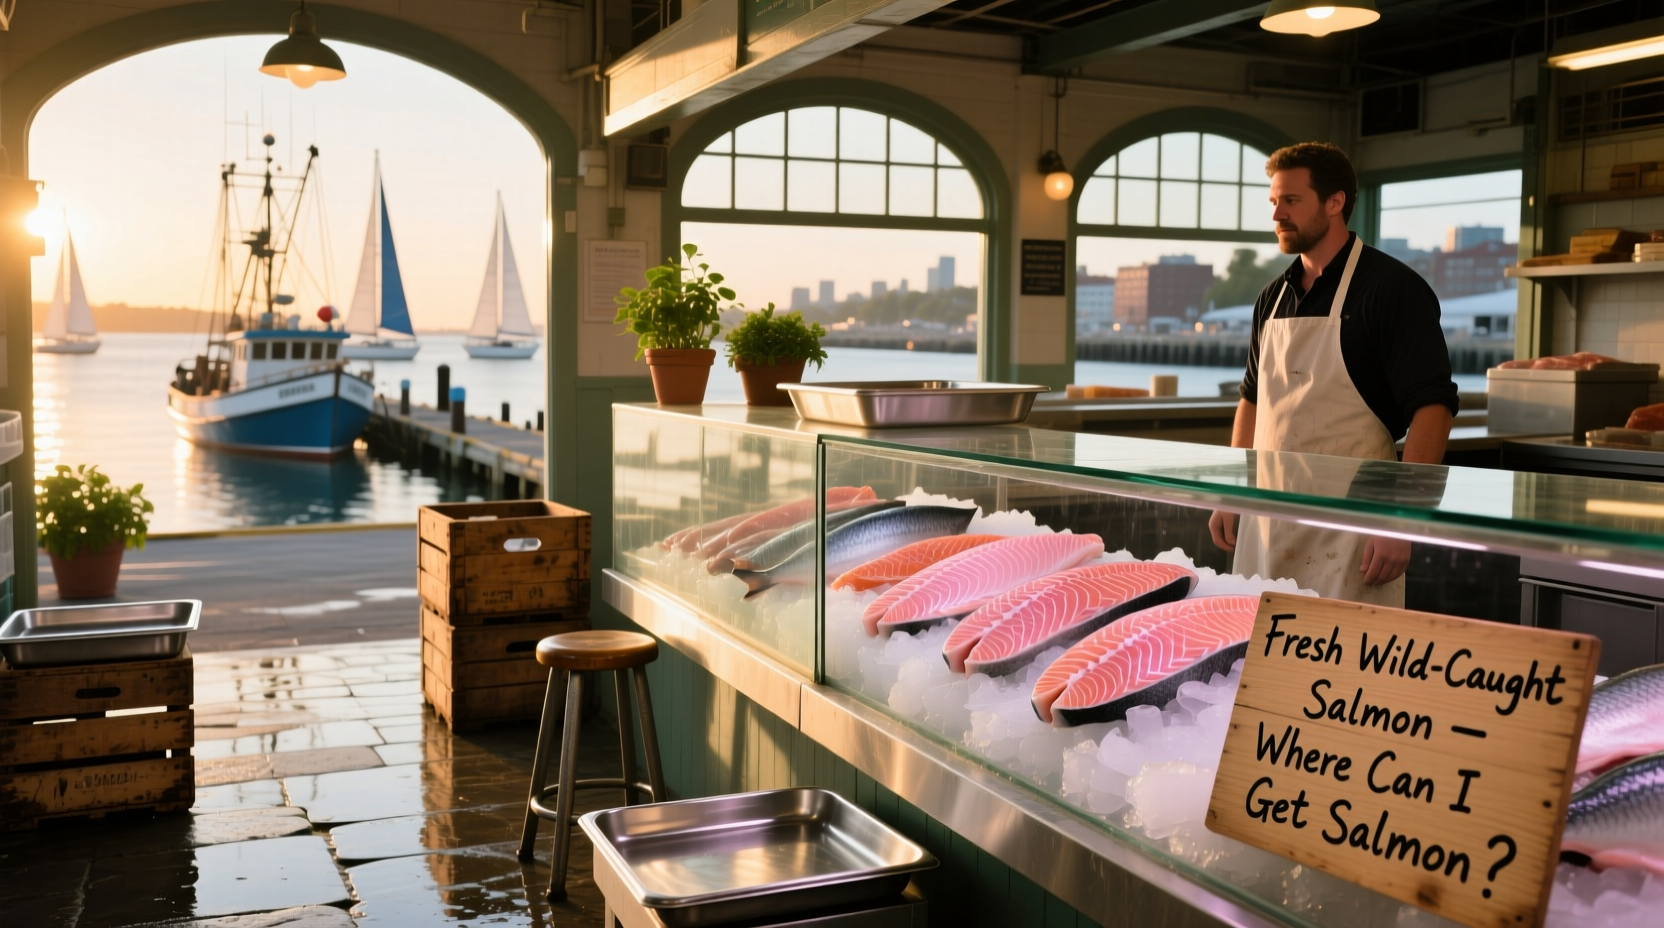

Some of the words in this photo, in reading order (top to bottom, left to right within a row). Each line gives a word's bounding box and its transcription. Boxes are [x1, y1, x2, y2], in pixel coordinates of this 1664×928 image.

[1264, 613, 1343, 666] Fresh
[1359, 632, 1566, 716] Wild-Caught
[1302, 678, 1433, 740] Salmon
[1245, 776, 1310, 829] Get
[1256, 721, 1352, 782] Where
[1367, 750, 1435, 804] Can
[1448, 768, 1482, 815] I
